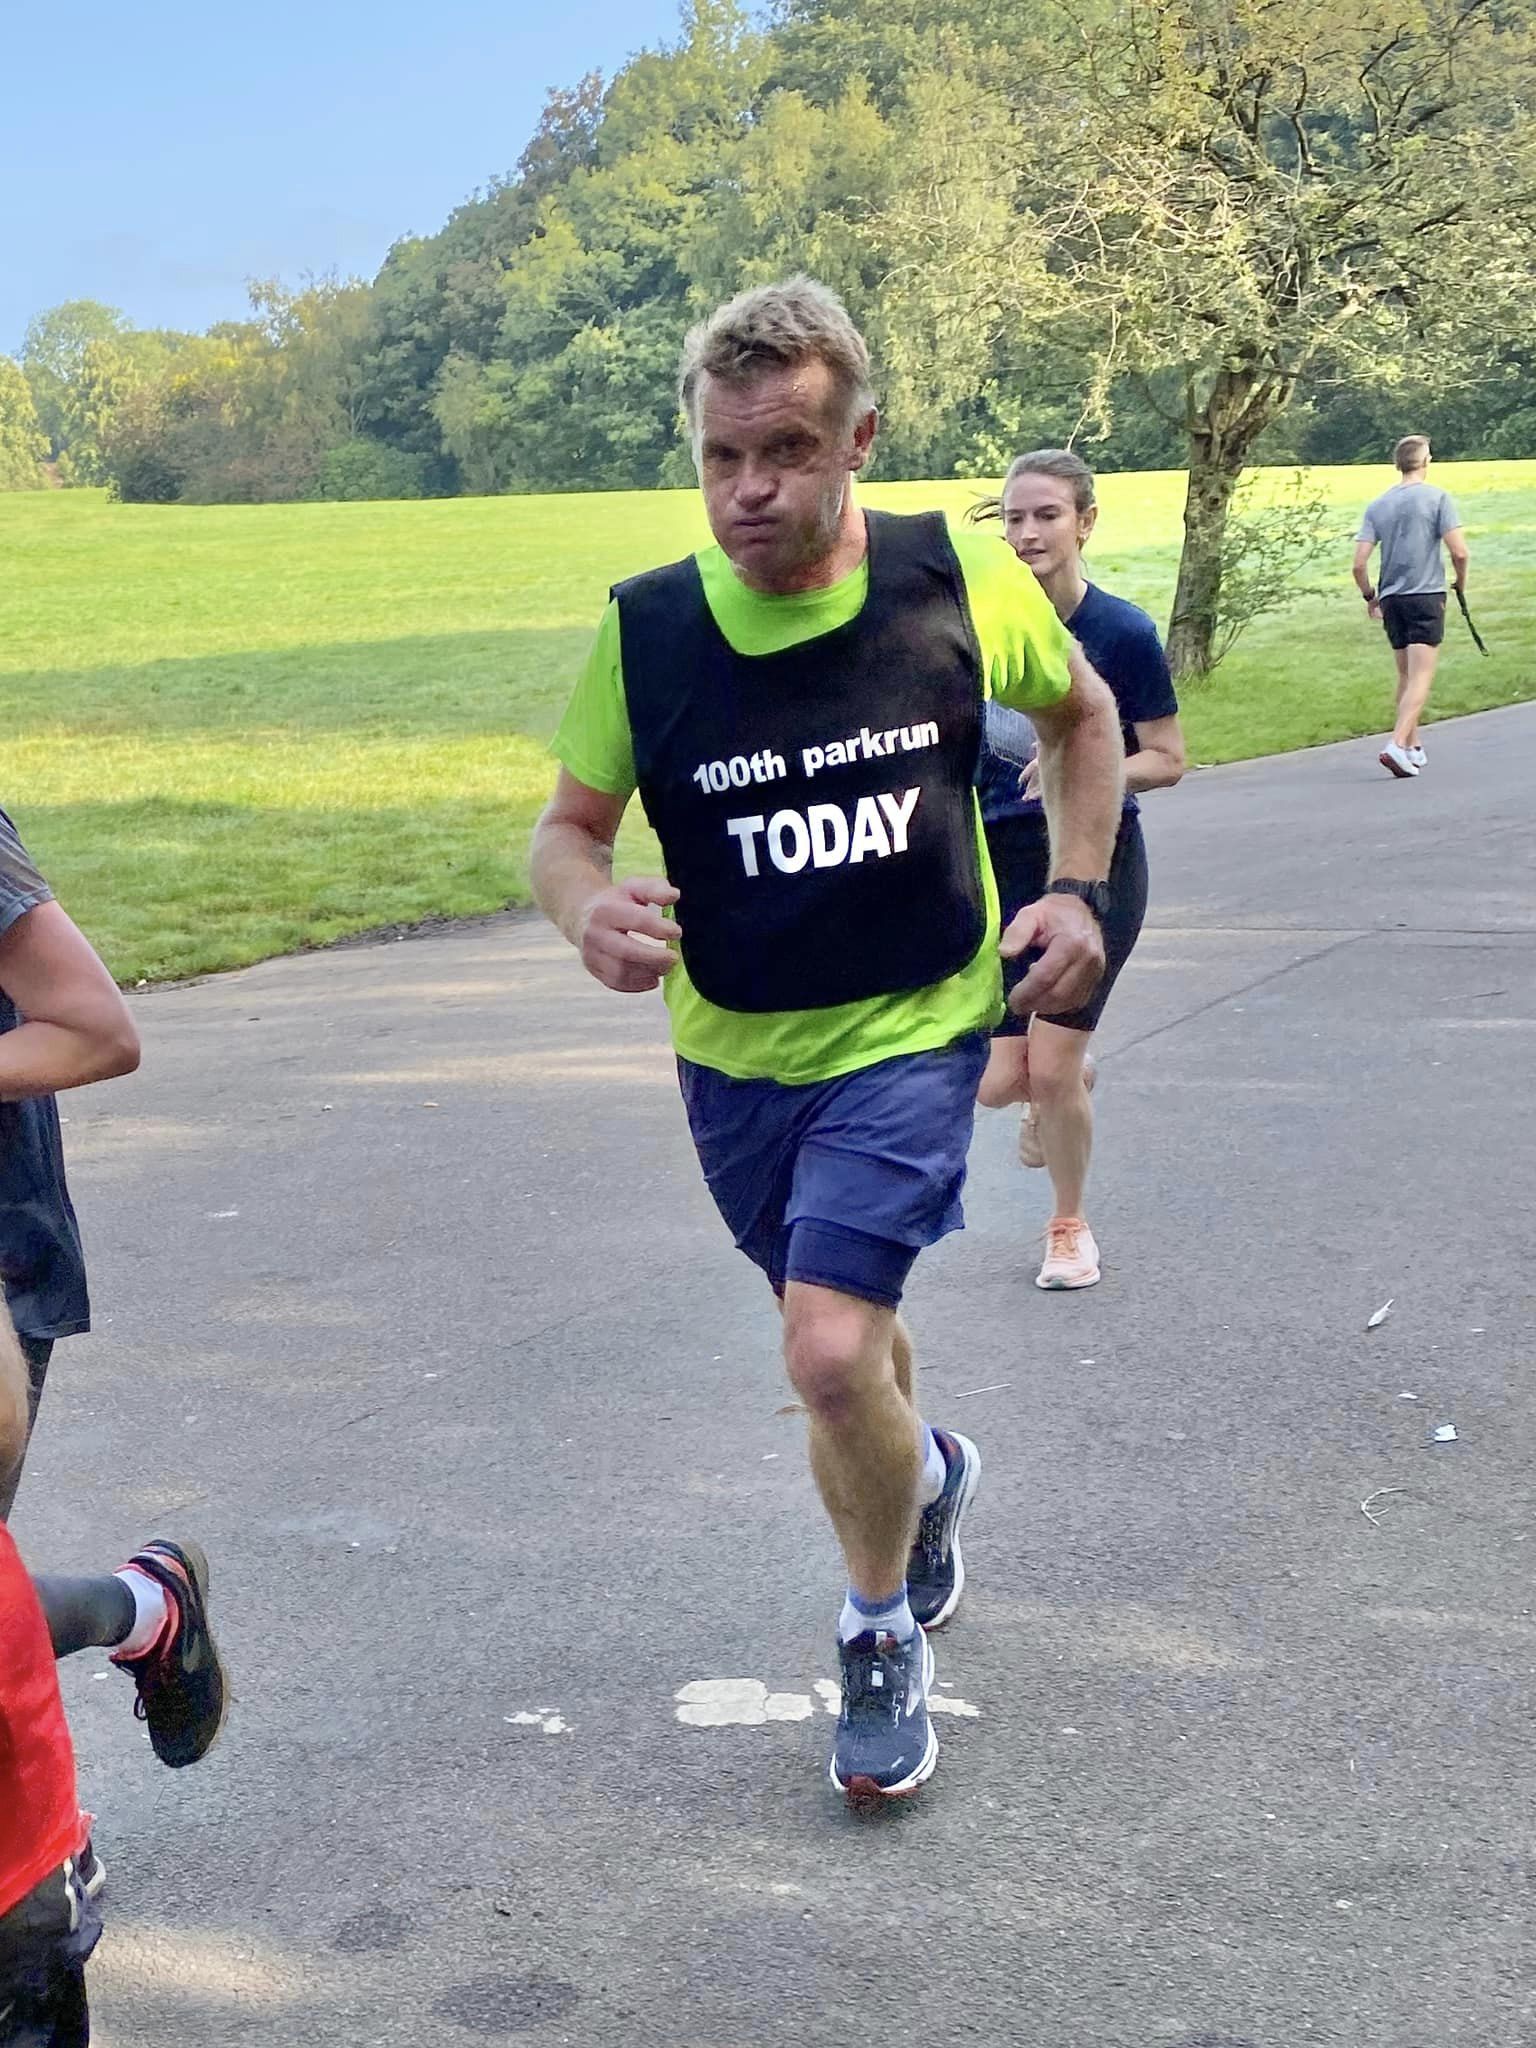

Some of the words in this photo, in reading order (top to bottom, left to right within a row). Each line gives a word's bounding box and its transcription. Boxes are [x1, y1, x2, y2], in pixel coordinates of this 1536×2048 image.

[693, 749, 787, 794] 100th
[802, 721, 940, 777] parkrun
[726, 787, 921, 877] TODAY
